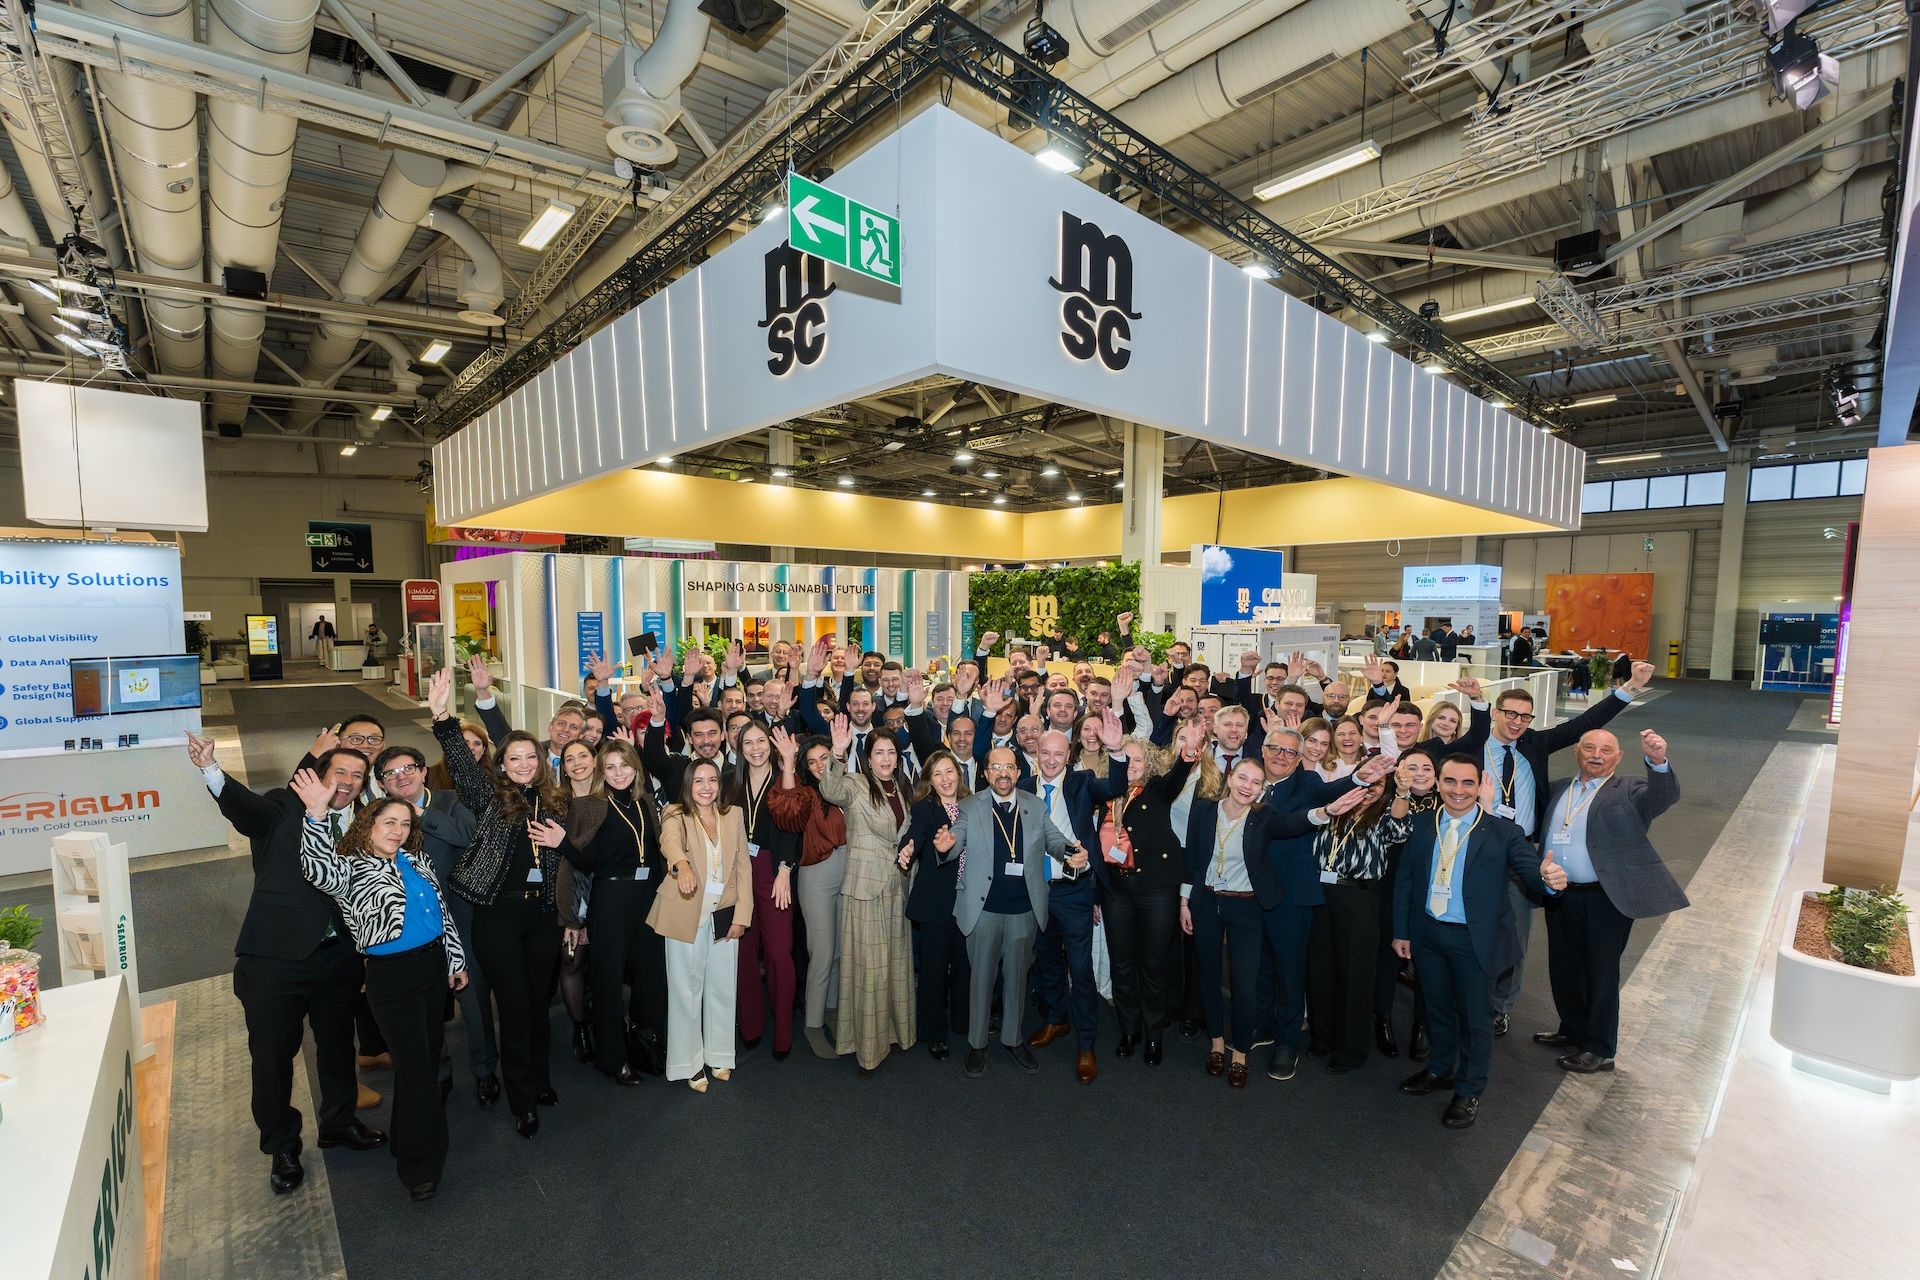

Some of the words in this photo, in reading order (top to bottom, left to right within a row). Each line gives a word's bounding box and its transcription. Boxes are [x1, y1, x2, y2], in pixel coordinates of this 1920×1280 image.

[0, 571, 60, 588] bility
[67, 572, 169, 587] Solutions
[687, 580, 744, 592] SHAPING
[747, 582, 755, 593] A
[758, 583, 833, 594] SUSTAINABLE
[836, 584, 876, 594] FUTURE
[49, 634, 98, 643] Visibility
[10, 659, 39, 667] Data
[12, 684, 49, 693] Safety
[13, 691, 72, 701] Design(No
[15, 716, 53, 725] Global
[11, 826, 40, 836] Time
[43, 821, 70, 831] Cold
[74, 817, 108, 828] Chain
[116, 923, 128, 970] SEAFRIGO
[83, 1049, 133, 1280] FRIGO
